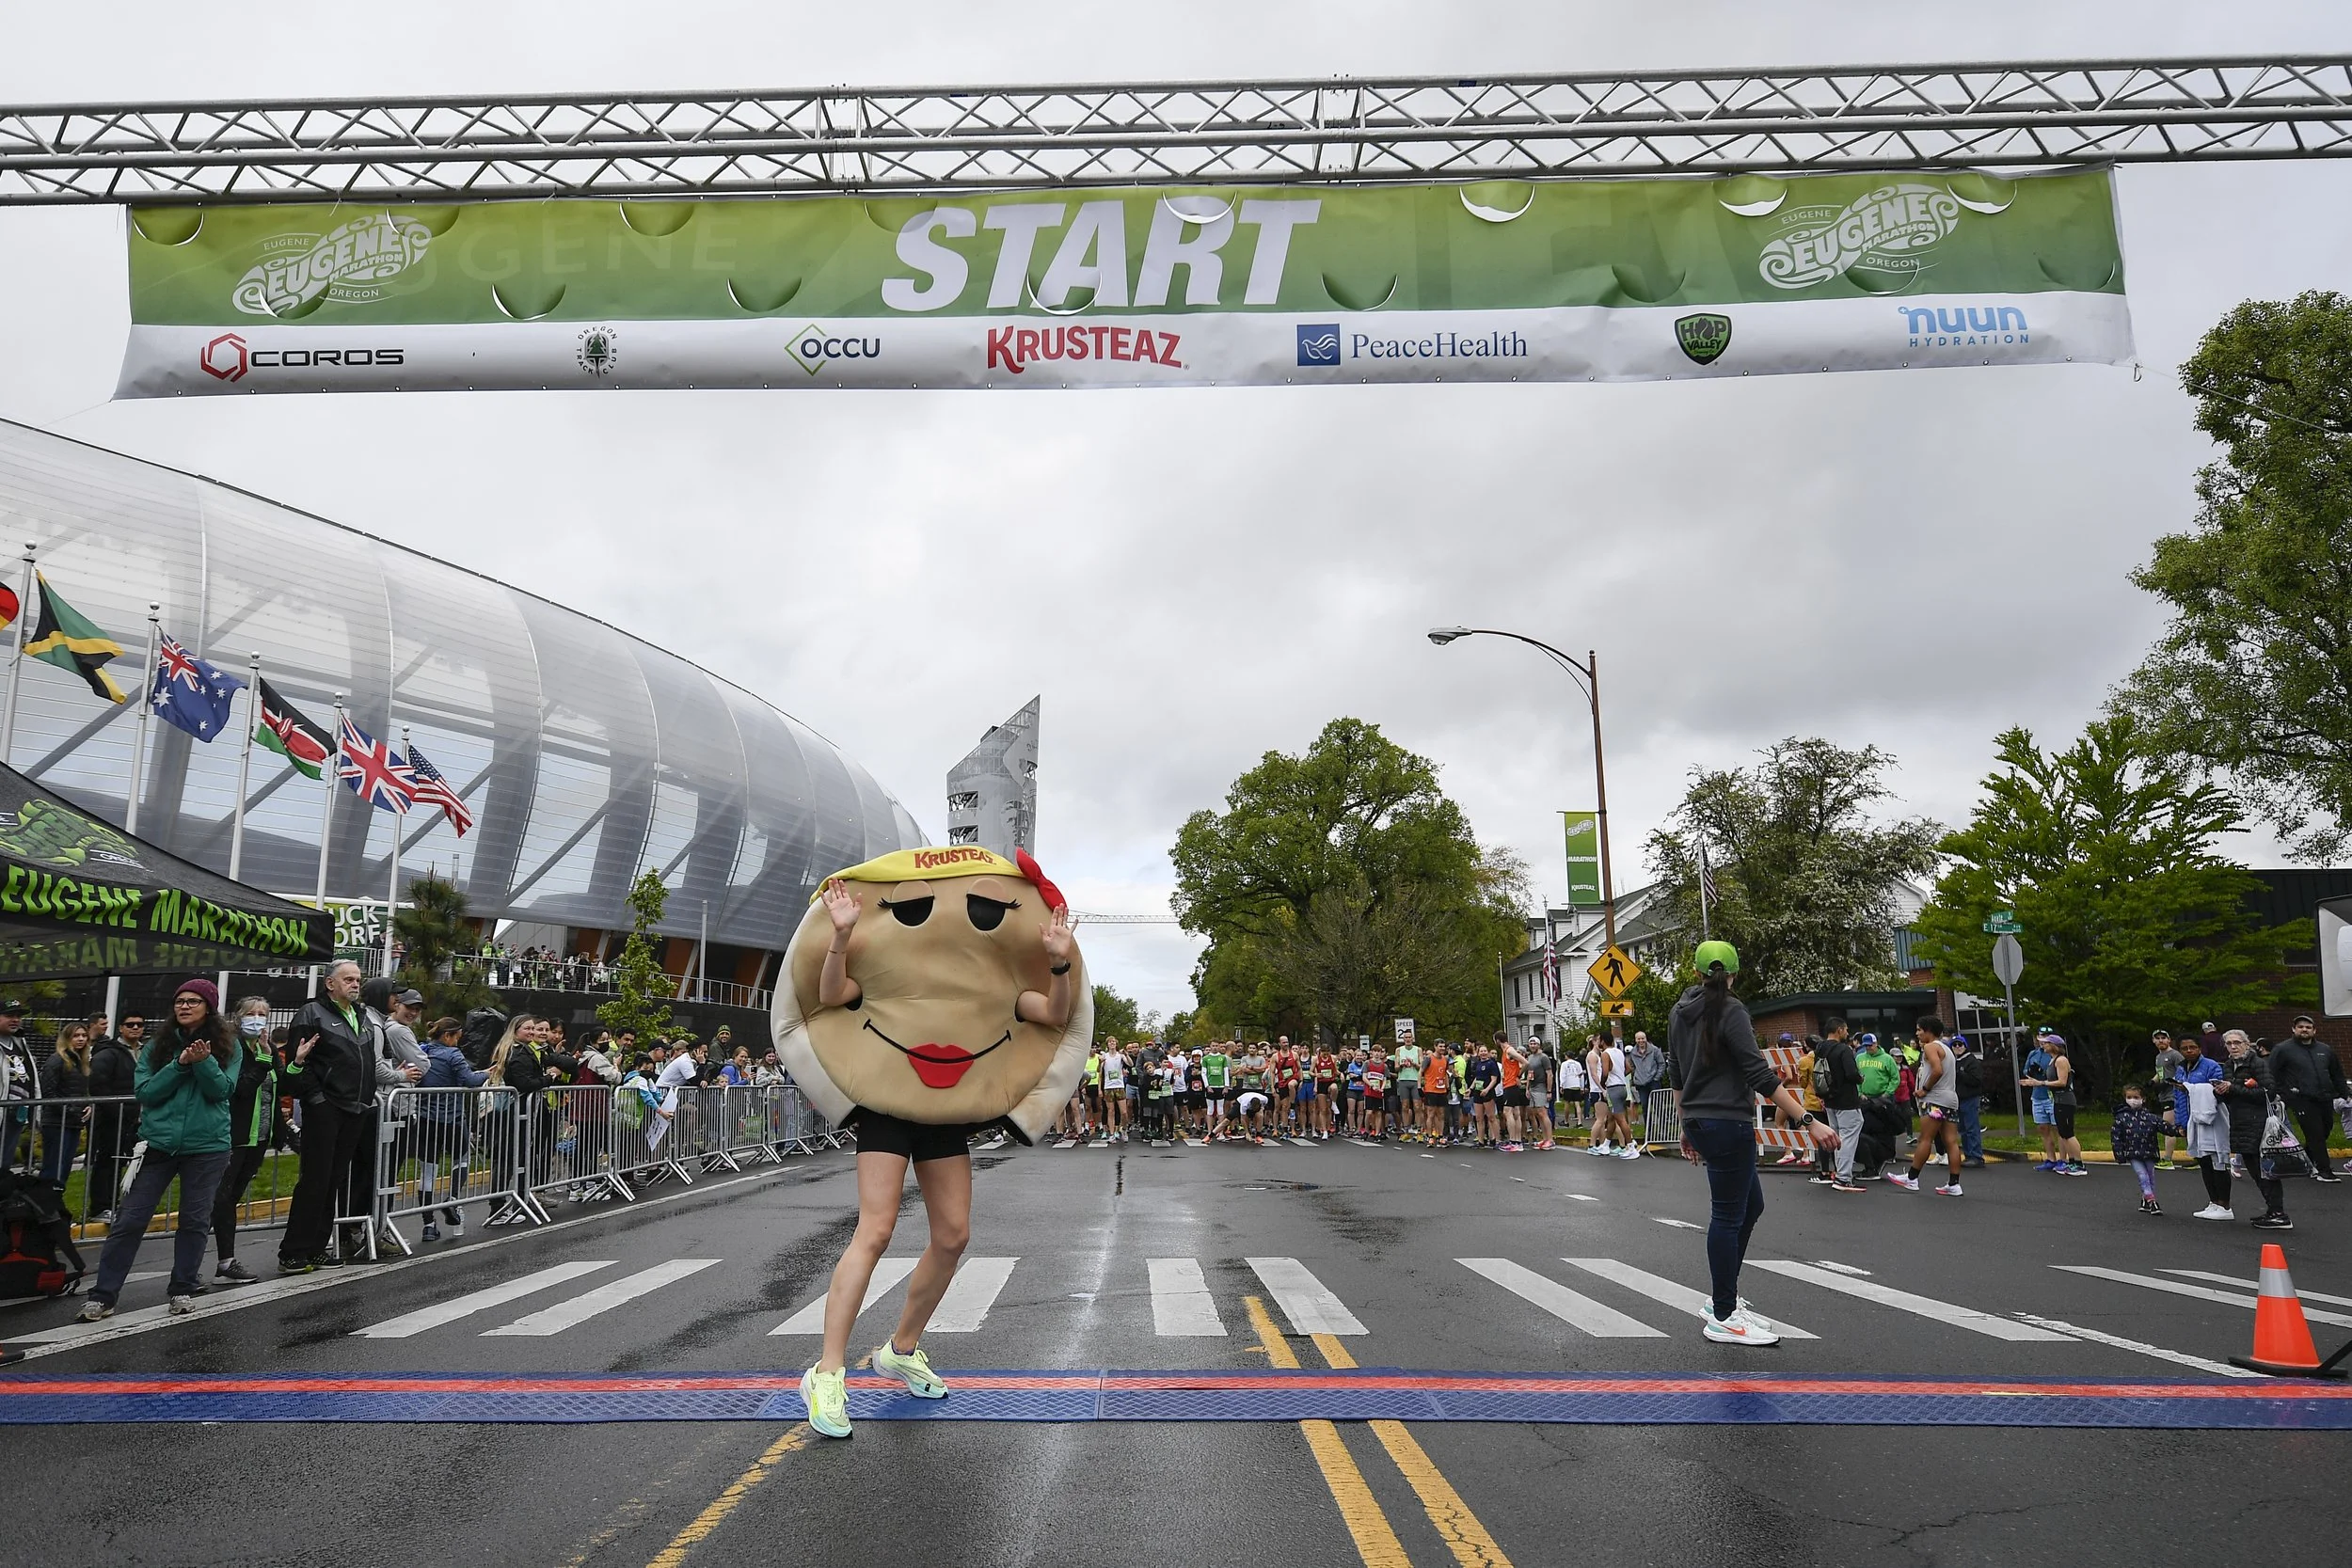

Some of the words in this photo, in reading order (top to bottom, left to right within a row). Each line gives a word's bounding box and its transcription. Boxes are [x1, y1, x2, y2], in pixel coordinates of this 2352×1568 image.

[1781, 210, 1831, 225] EUGENE
[263, 238, 310, 250] EUGENE
[1791, 194, 1931, 274] EUGENE
[1862, 223, 1936, 253] MARATHON
[266, 224, 404, 302] EUGENE
[881, 195, 1322, 312] START
[1866, 256, 1920, 268] OREGON
[329, 253, 404, 282] MARATHON
[329, 287, 380, 298] OREGON
[577, 325, 618, 340] OREGON
[1680, 317, 1727, 341] HOP
[1908, 306, 2028, 334] nuun
[800, 337, 881, 359] OCCU
[986, 325, 1186, 374] KRUSTEAZ
[1350, 331, 1529, 359] PeaceHealth
[1686, 339, 1723, 351] VALLEY
[1909, 333, 2029, 347] HYDRATION
[251, 348, 405, 368] COROS
[576, 348, 594, 374] TRACK
[603, 348, 617, 374] CLUB
[1, 863, 143, 929] EUGENE
[151, 888, 309, 958] MARATHON
[328, 905, 380, 927] UCK
